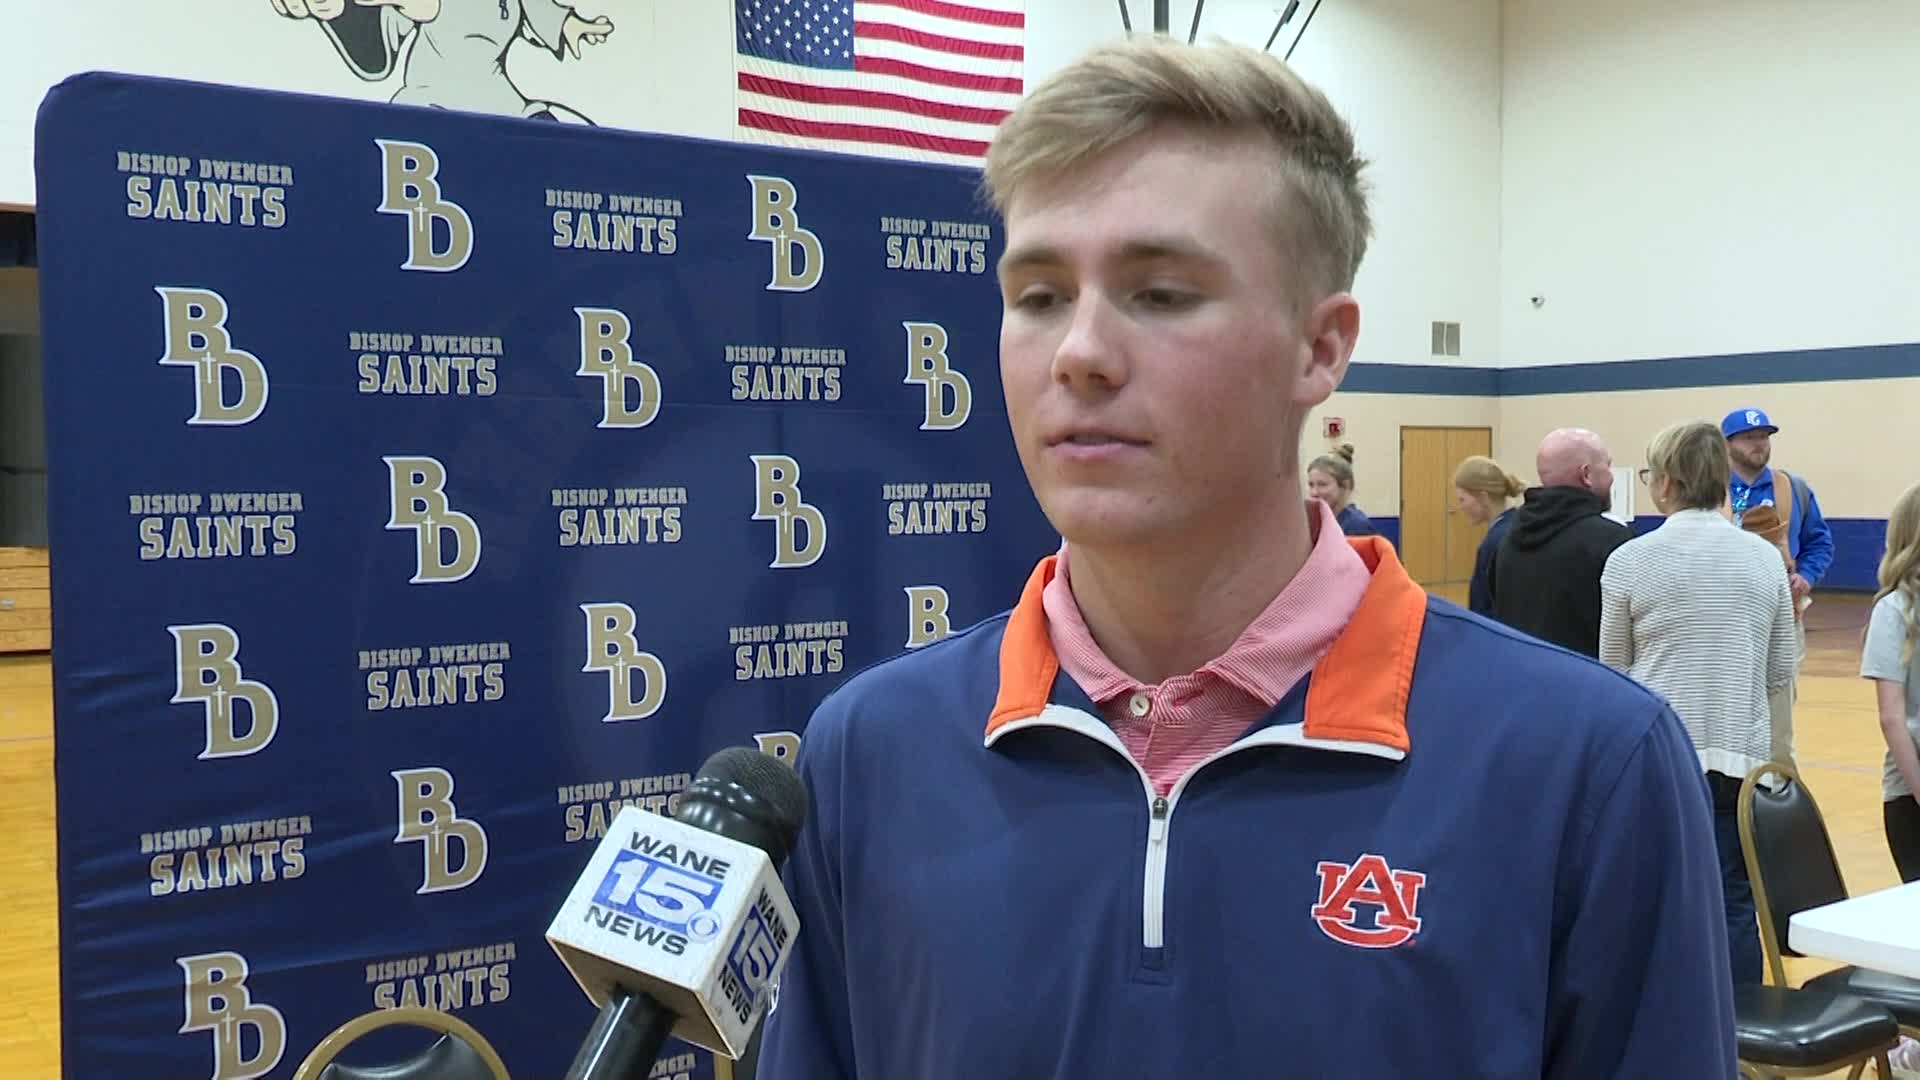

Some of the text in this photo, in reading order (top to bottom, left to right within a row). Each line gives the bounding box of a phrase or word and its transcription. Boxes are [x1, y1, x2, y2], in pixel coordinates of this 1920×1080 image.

[117, 151, 293, 185] BISHOP DWENGER
[127, 176, 286, 228] SAINTS
[545, 189, 682, 216] BISHOP DWENGER
[553, 210, 677, 255] SAINTS
[880, 217, 990, 240] BISHOP DWENGER
[886, 237, 987, 274] SAINTS
[349, 332, 503, 355] BISHOP DWENGER
[725, 345, 846, 366] BISHOP DWENGER
[358, 354, 498, 395] SAINTS
[731, 365, 841, 401] SAINTS
[129, 492, 303, 514] BISHOP DWENGER
[552, 487, 687, 507] BISHOP DWENGER
[883, 482, 992, 500] BISHOP DWENGER
[140, 515, 296, 560] SAINTS
[559, 506, 681, 546] SAINTS
[888, 500, 986, 535] SAINTS
[729, 621, 849, 644] BISHOP DWENGER
[904, 585, 962, 648] B
[359, 642, 510, 670] BISHOP DWENGER
[735, 640, 843, 680] SAINTS
[367, 663, 505, 710] SAINTS
[558, 780, 614, 804] BISHOP
[140, 816, 312, 853] BISHOP DWENGER
[150, 838, 306, 896] SAINTS
[629, 831, 731, 880] WANE
[607, 858, 716, 928] 15
[584, 905, 689, 956] NEWS
[758, 887, 788, 949] WANE
[366, 942, 516, 982] BISHOP DWENGER
[734, 918, 776, 992] 15
[374, 963, 509, 1011] SAINTS
[718, 964, 751, 1025] NEWS
